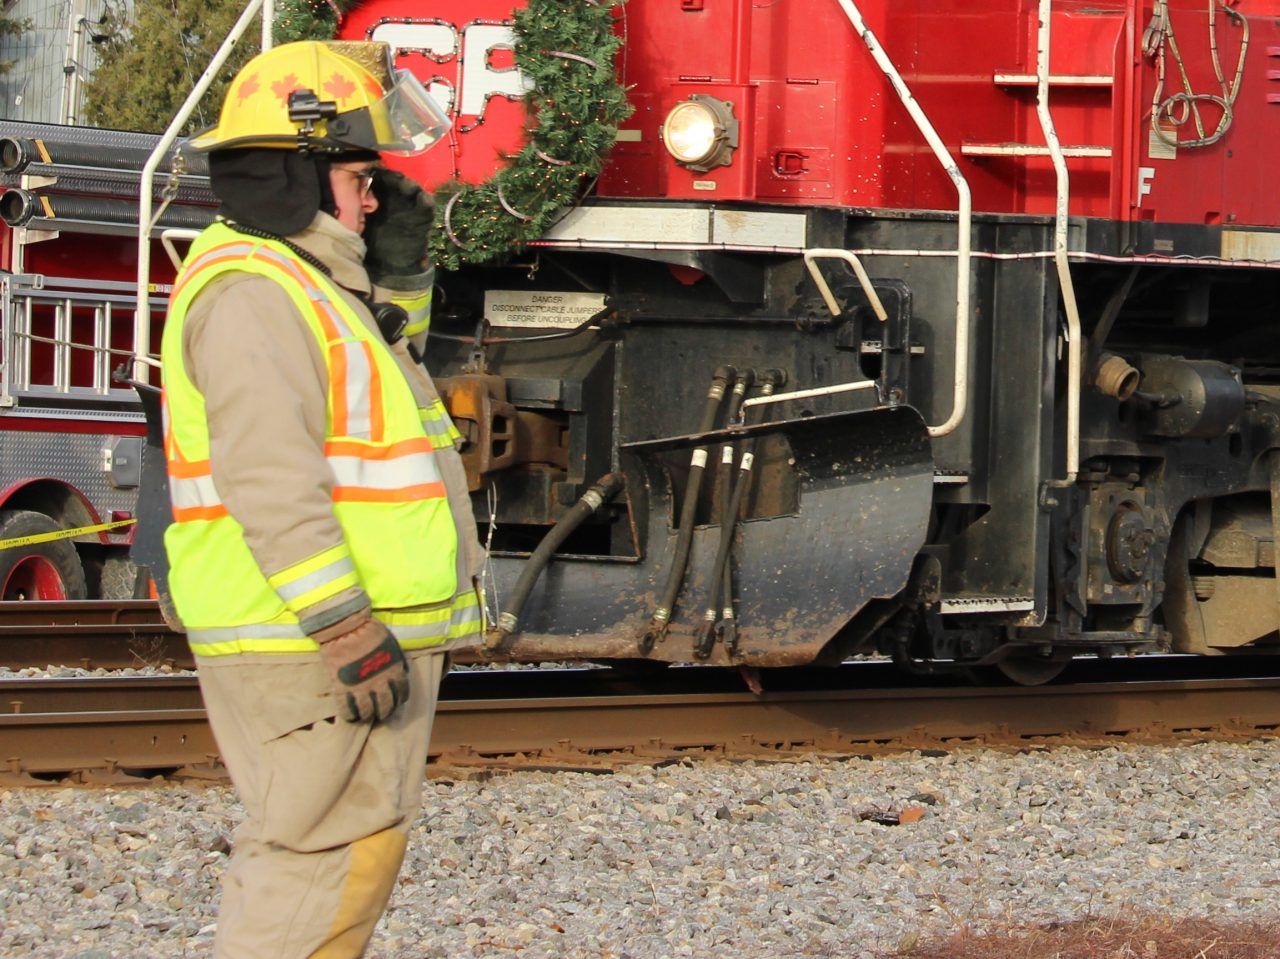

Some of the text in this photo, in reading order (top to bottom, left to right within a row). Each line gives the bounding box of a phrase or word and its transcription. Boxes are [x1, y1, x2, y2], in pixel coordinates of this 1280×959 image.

[1138, 167, 1155, 207] F
[531, 295, 563, 304] DANGER
[492, 304, 540, 313] DISCONNECT
[541, 305, 565, 314] CABLE
[507, 314, 537, 323] BEFORE
